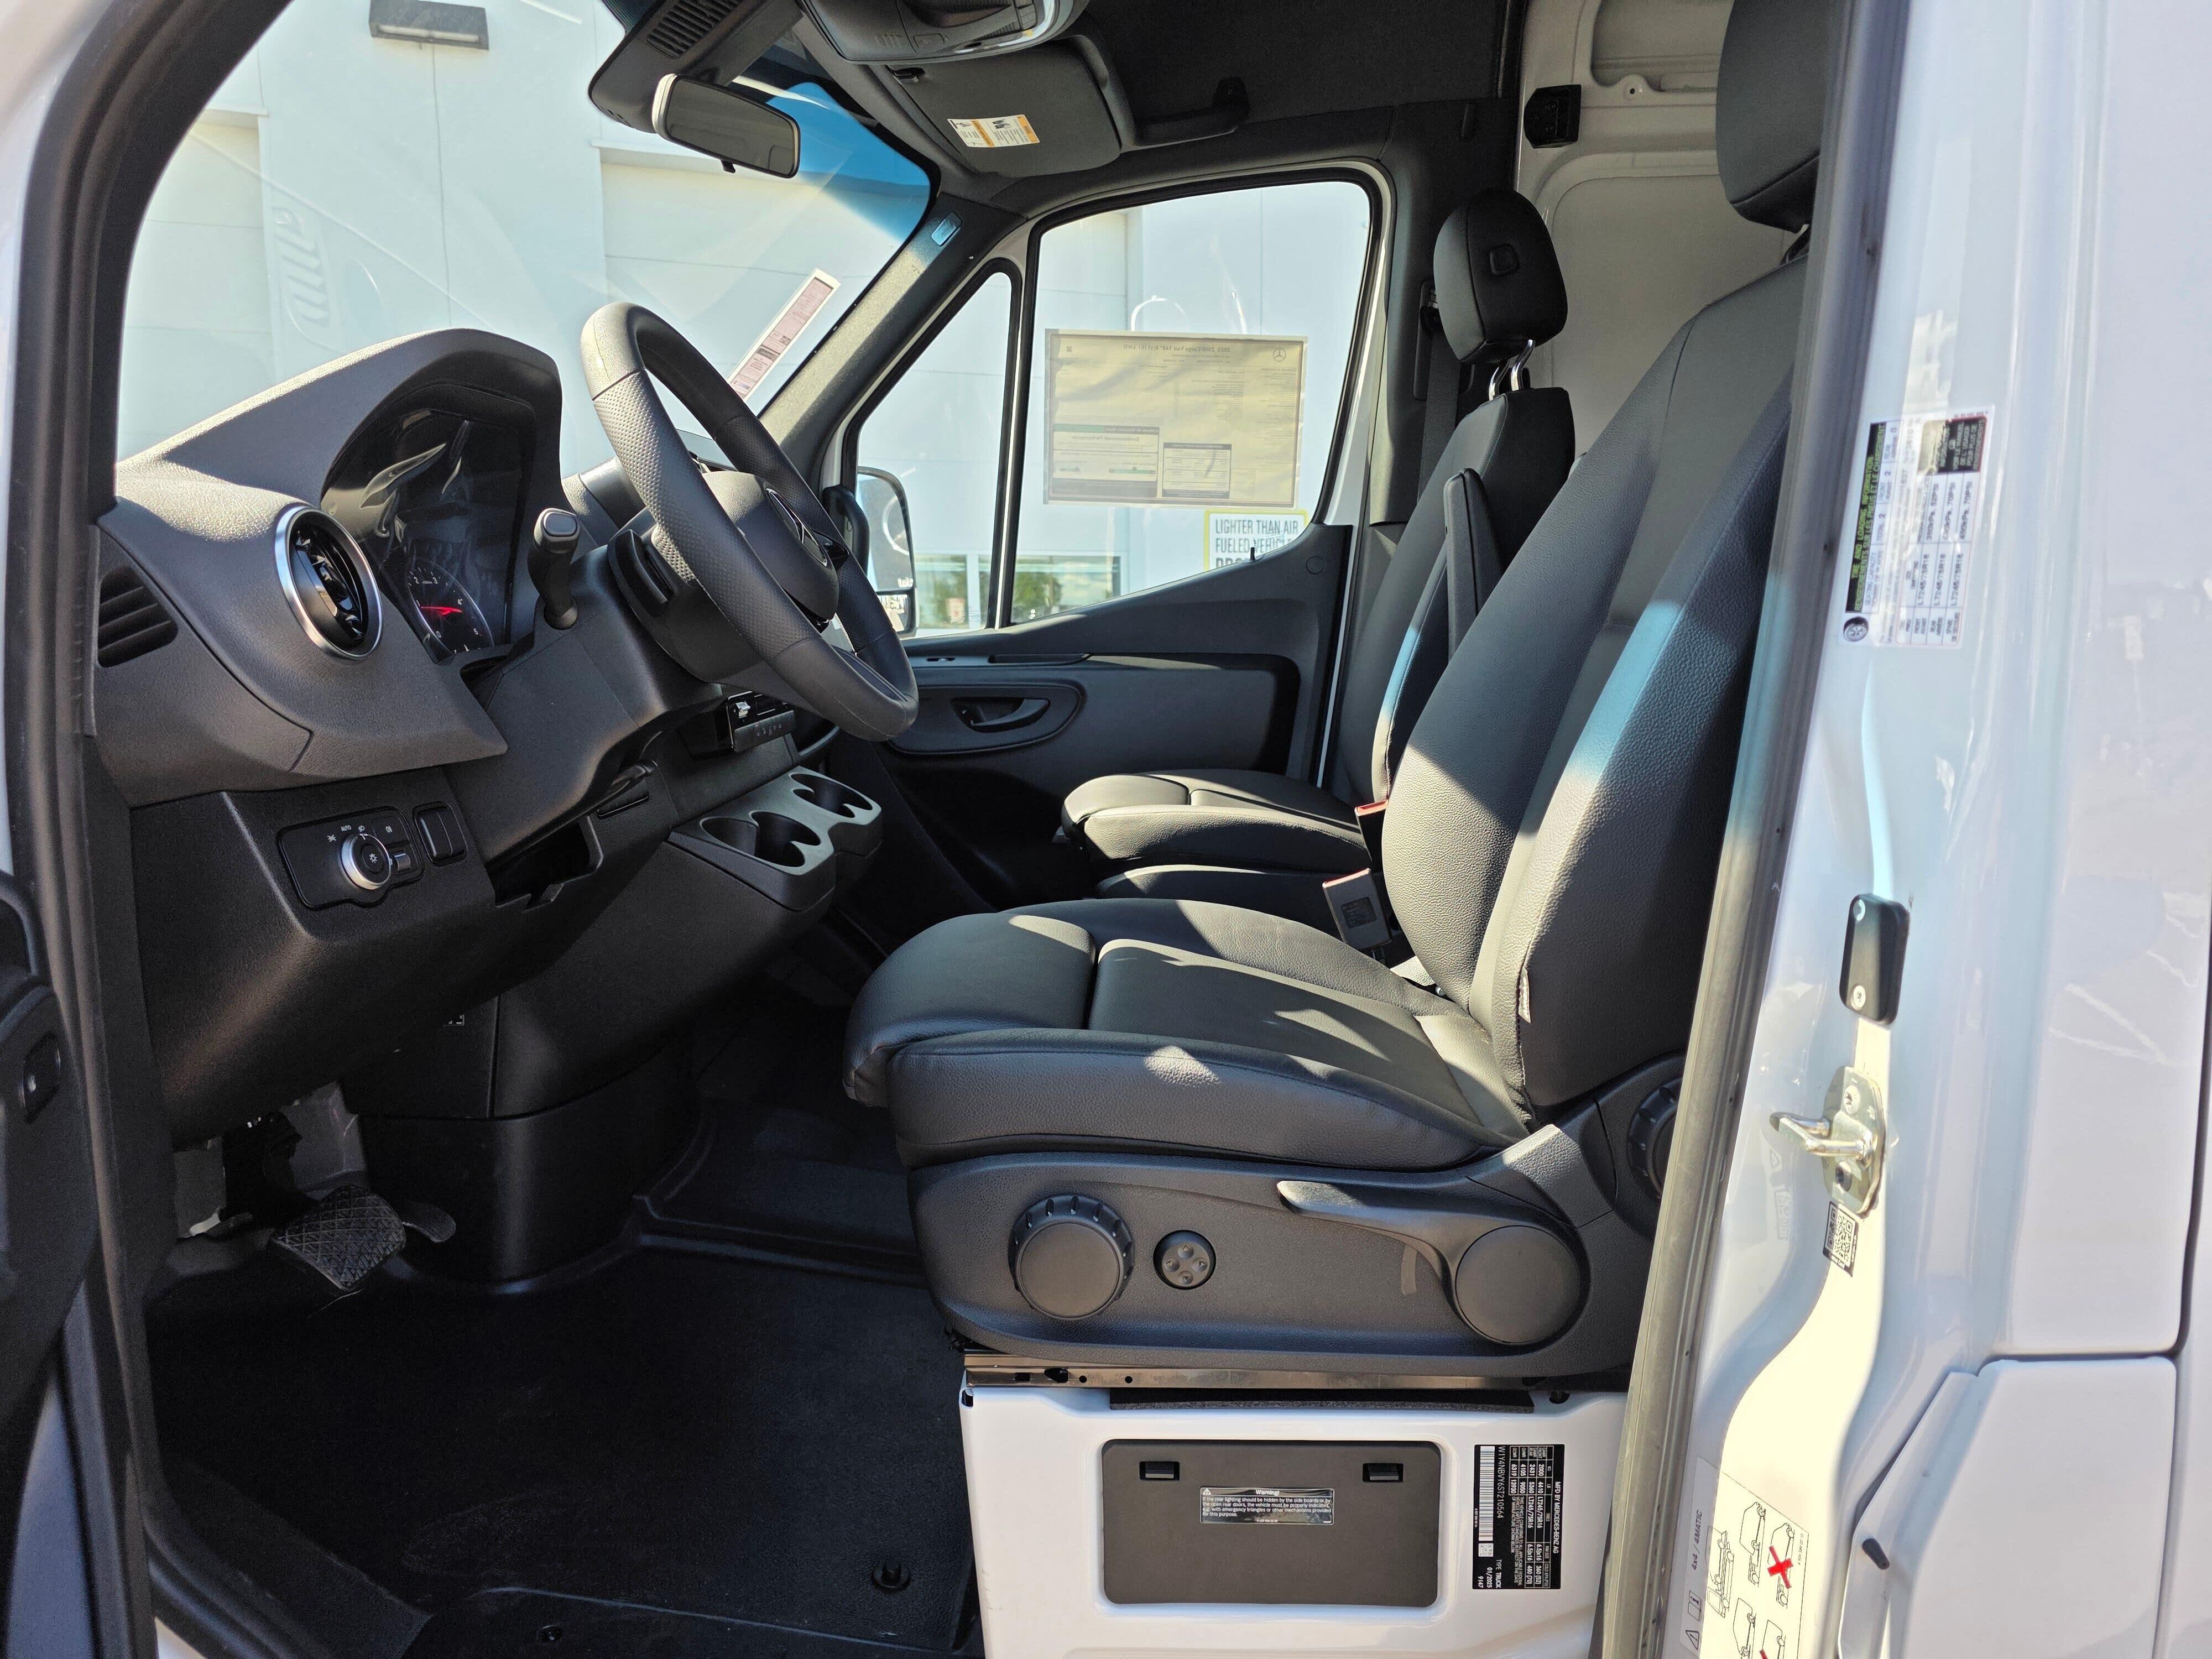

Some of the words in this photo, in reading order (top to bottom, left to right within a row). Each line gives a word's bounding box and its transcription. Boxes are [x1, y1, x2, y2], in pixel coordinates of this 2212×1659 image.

[1869, 484, 1877, 493] ET
[1870, 473, 1878, 483] LE
[1851, 564, 1860, 578] TIRE
[1861, 457, 1874, 504] INFORMATION
[1867, 494, 1876, 518] PNEUS
[1215, 519, 1254, 534] LIGHTER
[1256, 520, 1281, 535] THAN
[1284, 520, 1298, 534] AIR
[1862, 534, 1871, 547] SUR
[1216, 538, 1250, 553] FUELED
[1917, 554, 1930, 606] LT245/75R16
[1930, 483, 1939, 507] 52PSI
[1933, 554, 1947, 606] LT245/75R16
[1947, 482, 1955, 505] 70PSI
[1950, 553, 1963, 606] LT245/75R16
[1963, 481, 1973, 505] 70PSI
[1867, 551, 1877, 580] CAPACITY
[1854, 550, 1869, 611] RENSEIGNEMENTS
[1497, 1446, 1506, 1519] W1Y4NBVY6ST210564
[1694, 1509, 1702, 1545] 4MATIC
[1693, 1543, 1700, 1554] /
